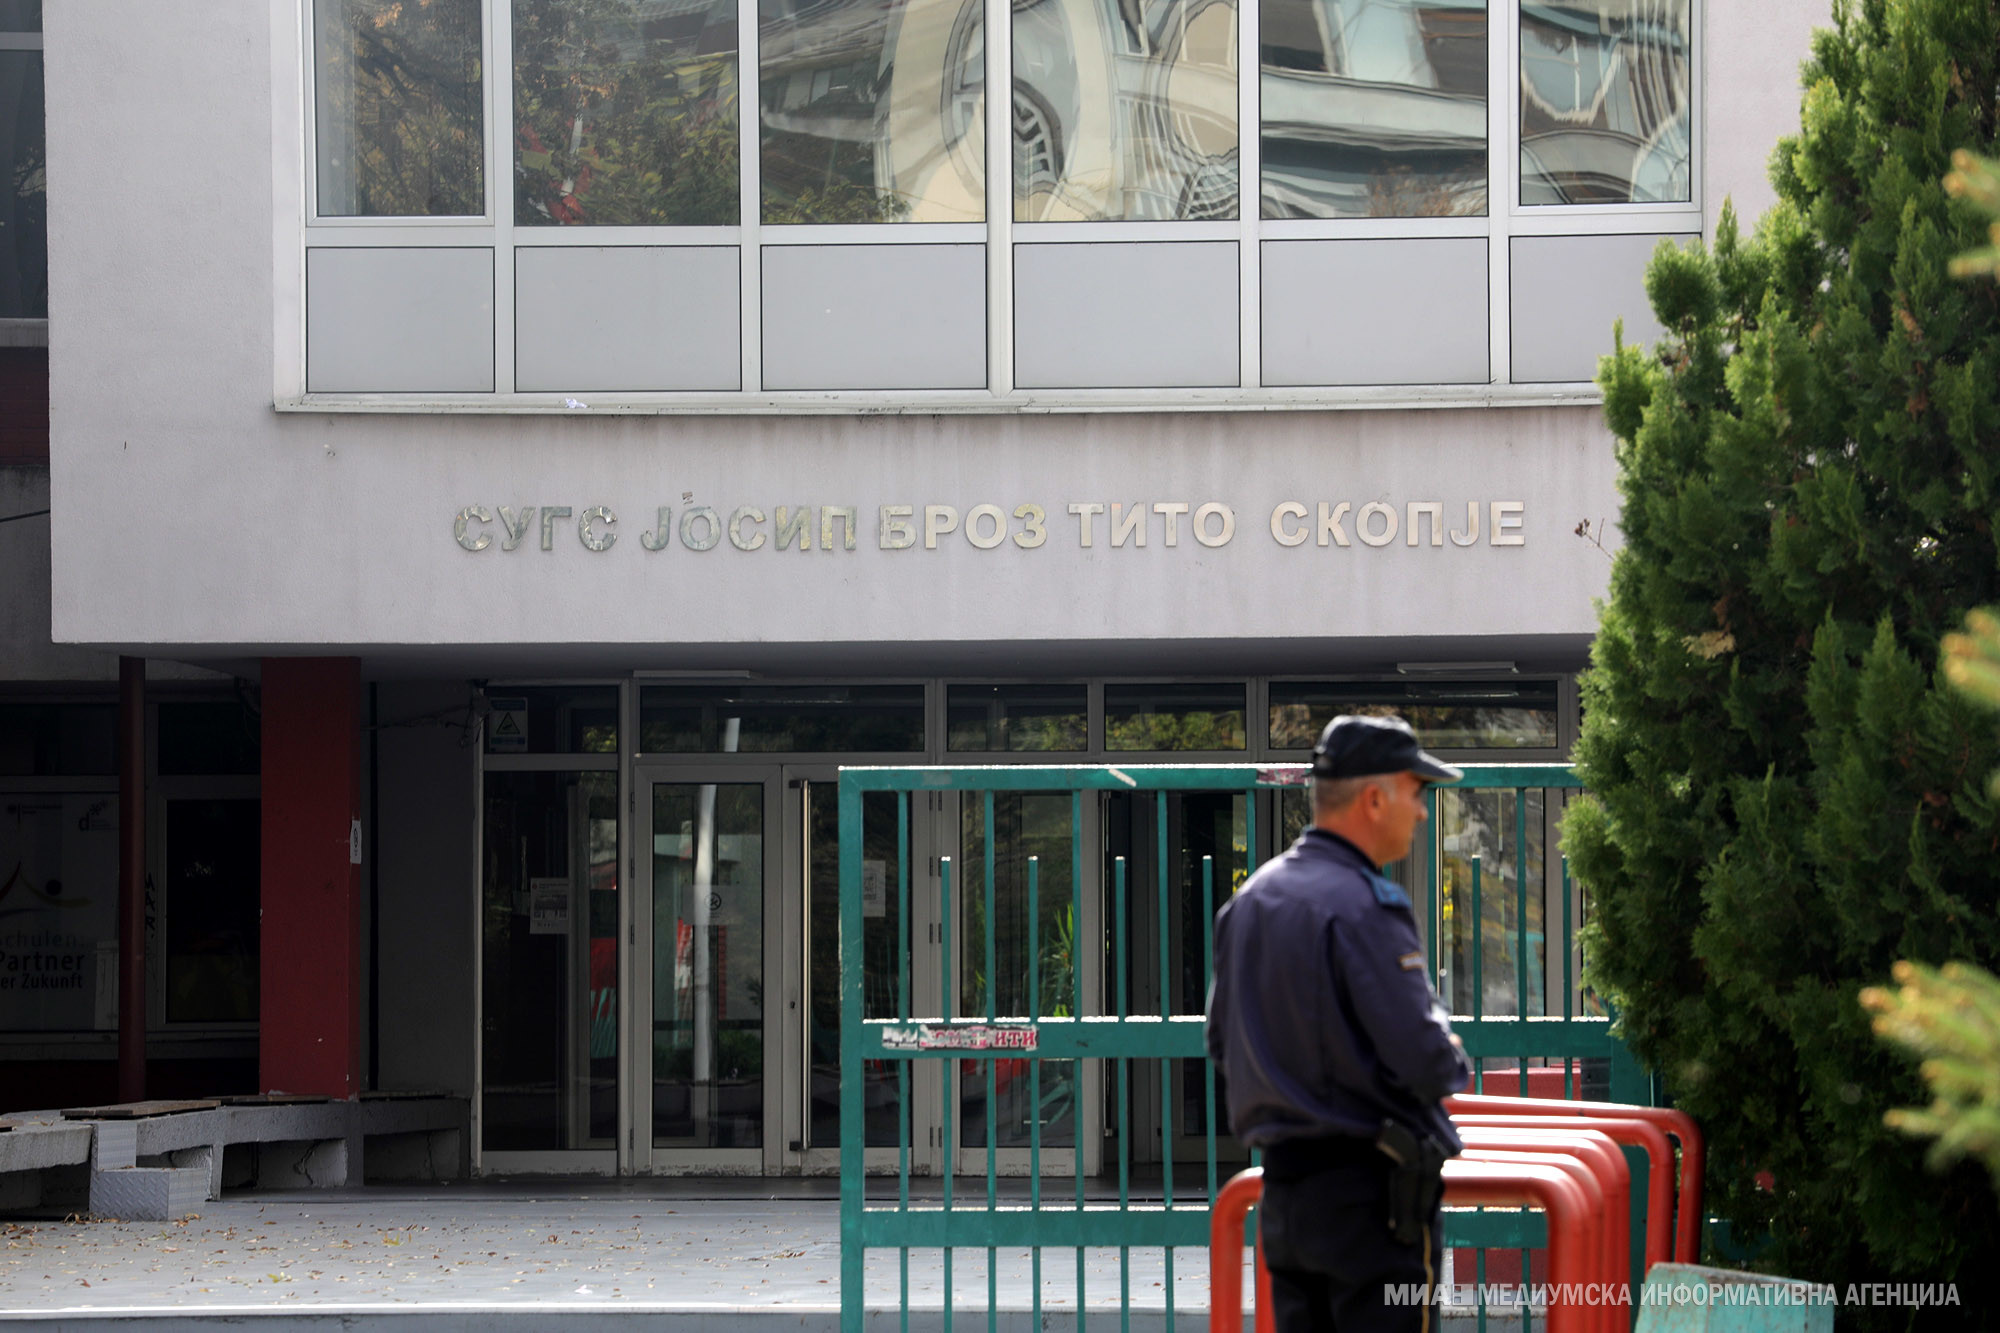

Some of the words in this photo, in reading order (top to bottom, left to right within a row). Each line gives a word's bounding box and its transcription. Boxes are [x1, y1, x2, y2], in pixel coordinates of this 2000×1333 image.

[454, 505, 619, 552] СУГС
[640, 505, 857, 552] ЈОСИП
[879, 504, 1048, 551] БРОЗ
[1067, 502, 1236, 549] ТИТО
[1269, 500, 1525, 549] СКОПЈЕ
[22, 973, 83, 989] Zukunft
